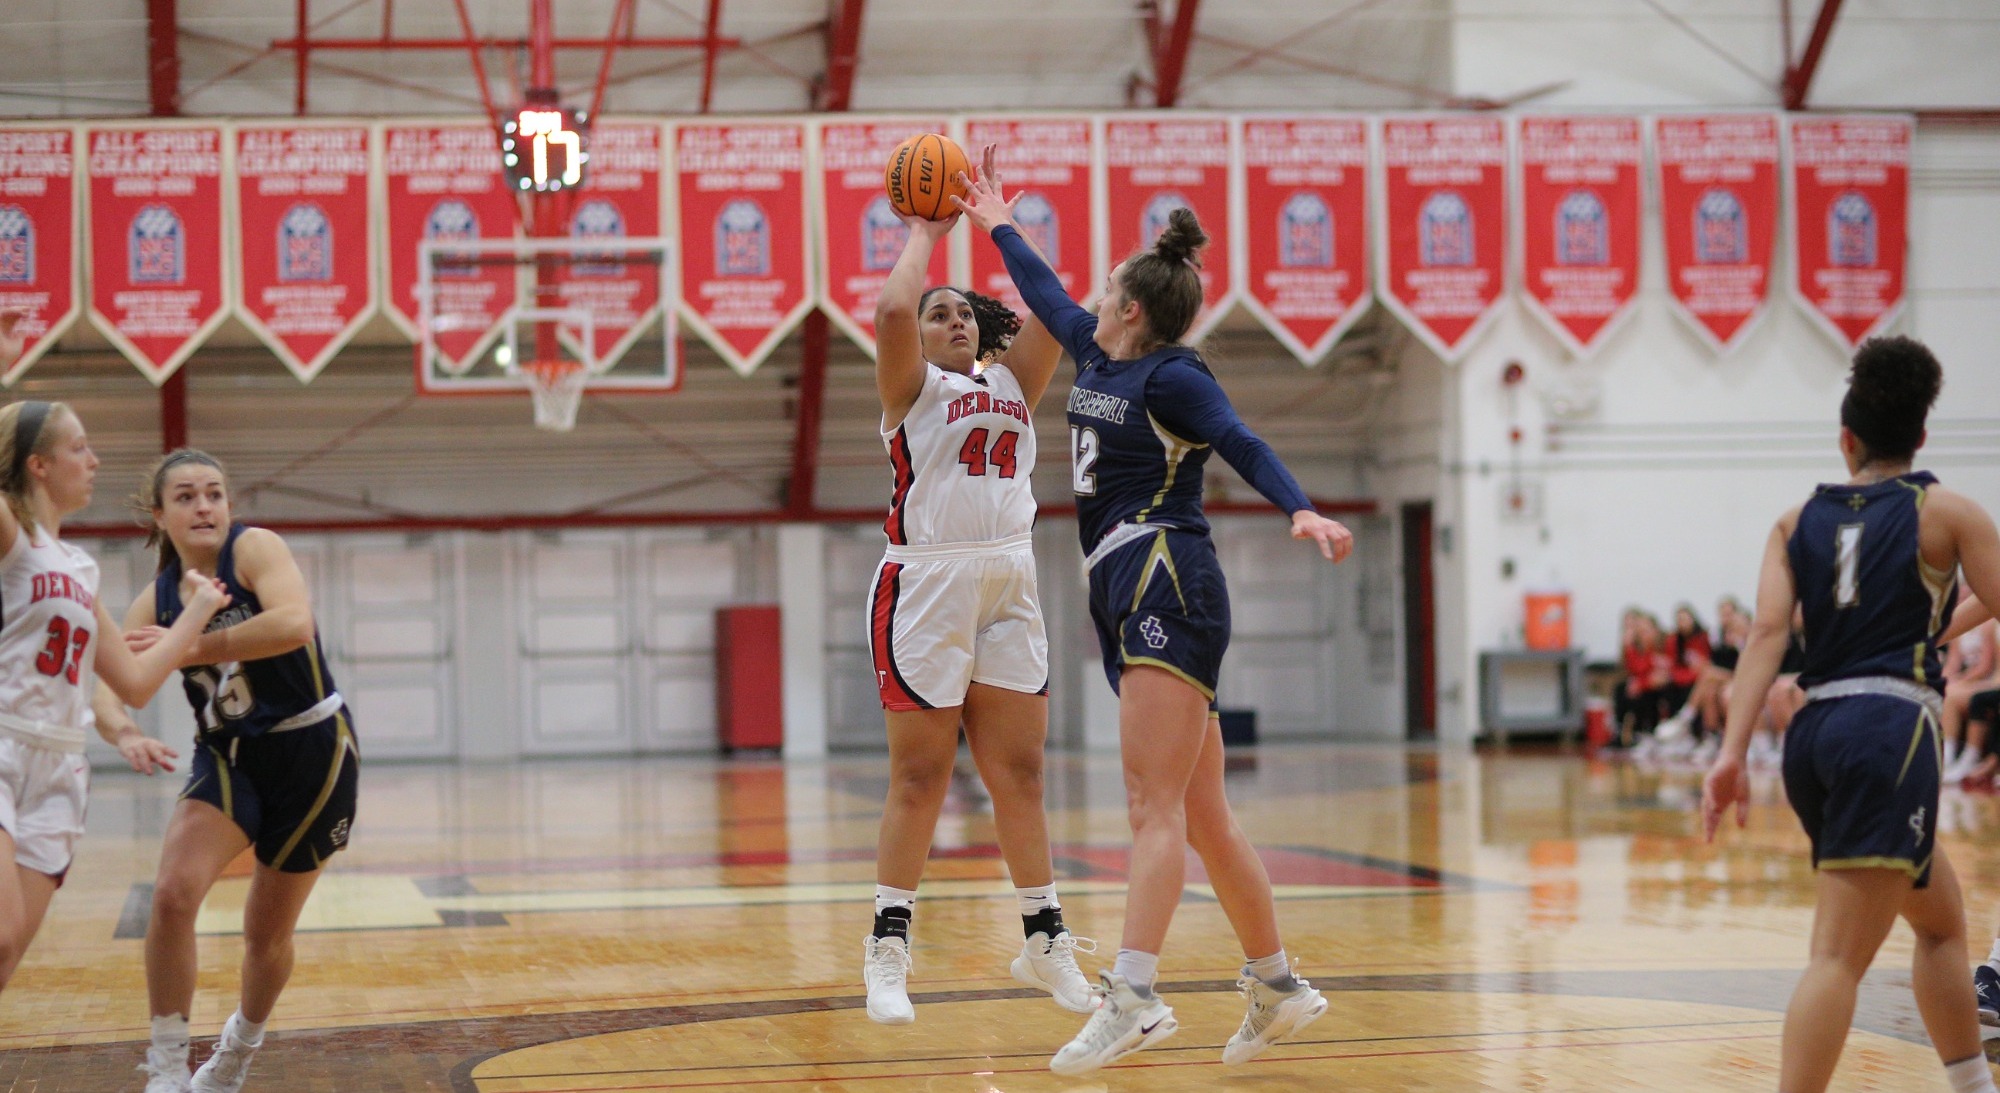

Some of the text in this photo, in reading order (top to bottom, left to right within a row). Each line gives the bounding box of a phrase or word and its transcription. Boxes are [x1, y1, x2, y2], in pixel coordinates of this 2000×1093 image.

[891, 146, 910, 203] Wilson
[919, 158, 933, 195] EVO
[1074, 387, 1130, 425] CARROLL
[958, 427, 1020, 480] 44
[1070, 423, 1100, 497] 12
[31, 570, 96, 614] DENIS
[1832, 522, 1865, 609] 1
[35, 614, 90, 688] 33
